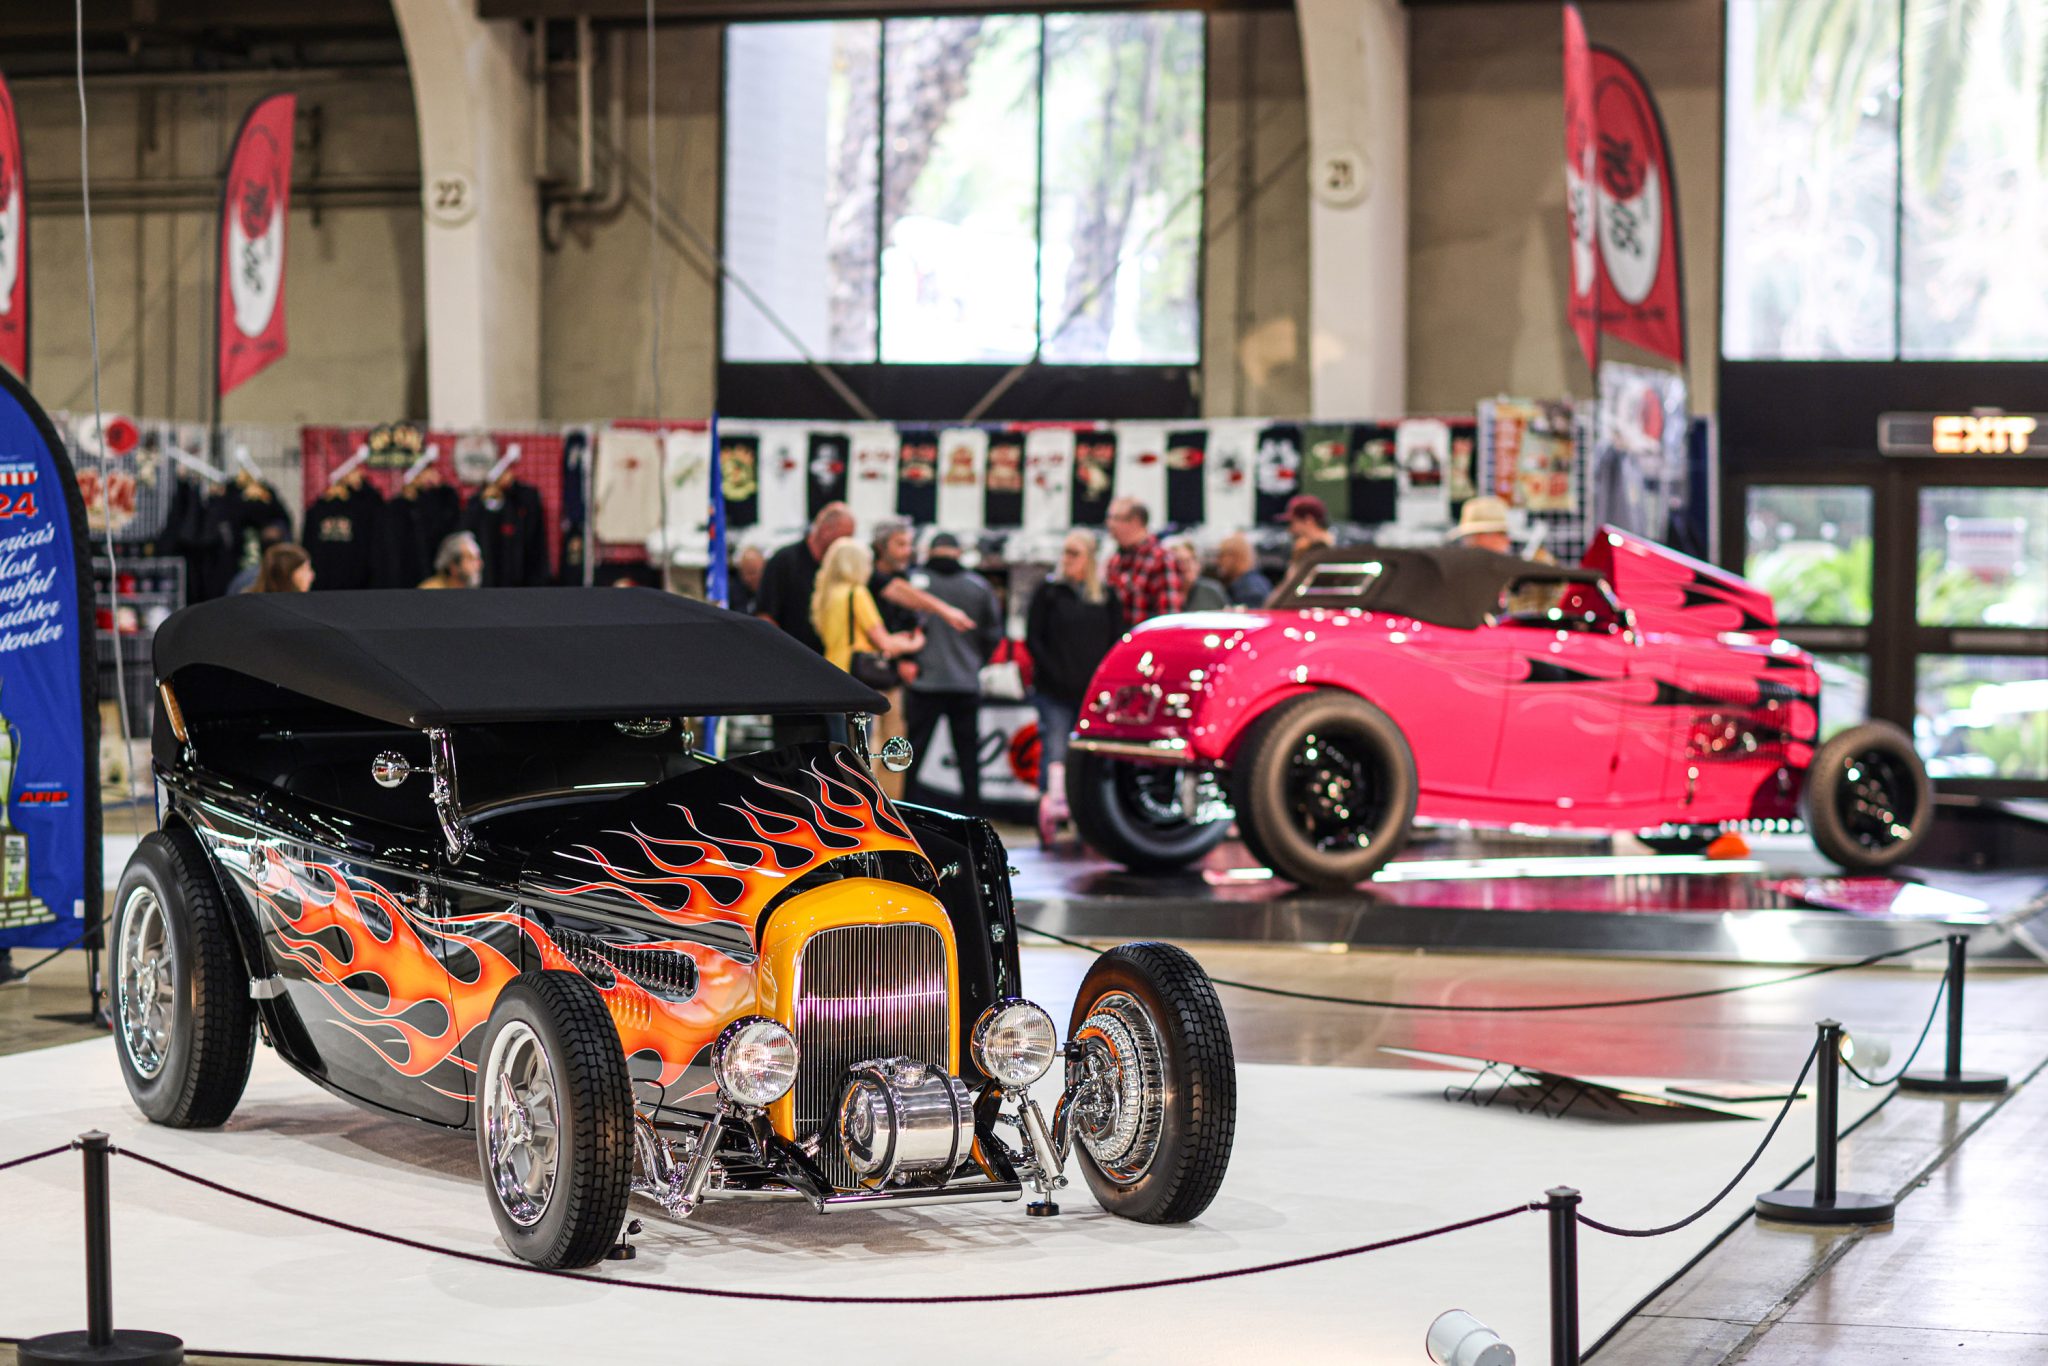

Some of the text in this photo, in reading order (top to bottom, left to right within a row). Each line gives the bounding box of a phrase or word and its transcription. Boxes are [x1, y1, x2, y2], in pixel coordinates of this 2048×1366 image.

[435, 180, 465, 209] 22
[1933, 416, 2037, 453] EXIT
[18, 791, 69, 803] ARP
